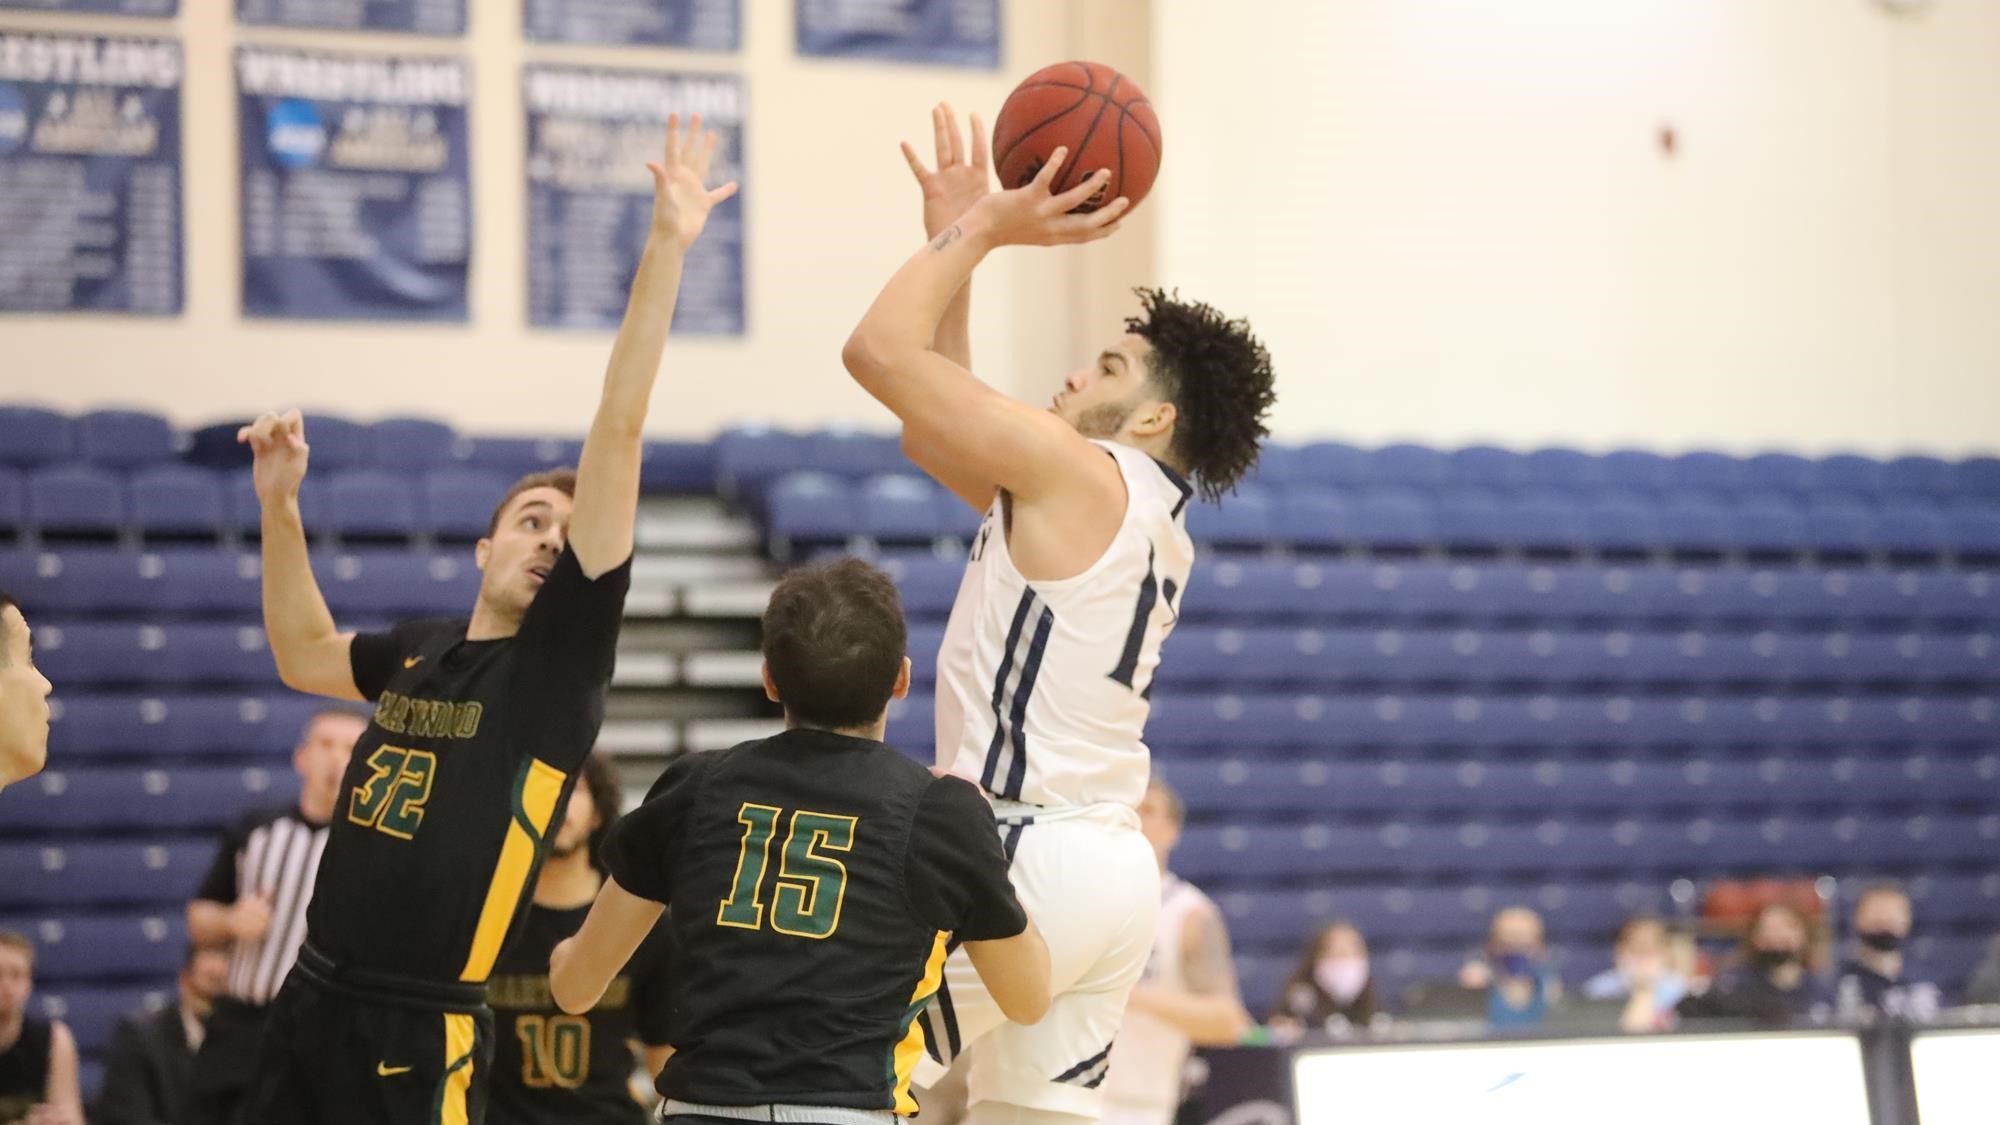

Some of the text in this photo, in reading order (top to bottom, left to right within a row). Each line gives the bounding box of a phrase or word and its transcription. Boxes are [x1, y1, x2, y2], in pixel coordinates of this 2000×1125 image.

[0, 37, 180, 87] ESTLING
[348, 744, 437, 840] 32
[716, 802, 859, 940] 15
[515, 1014, 591, 1089] 10
